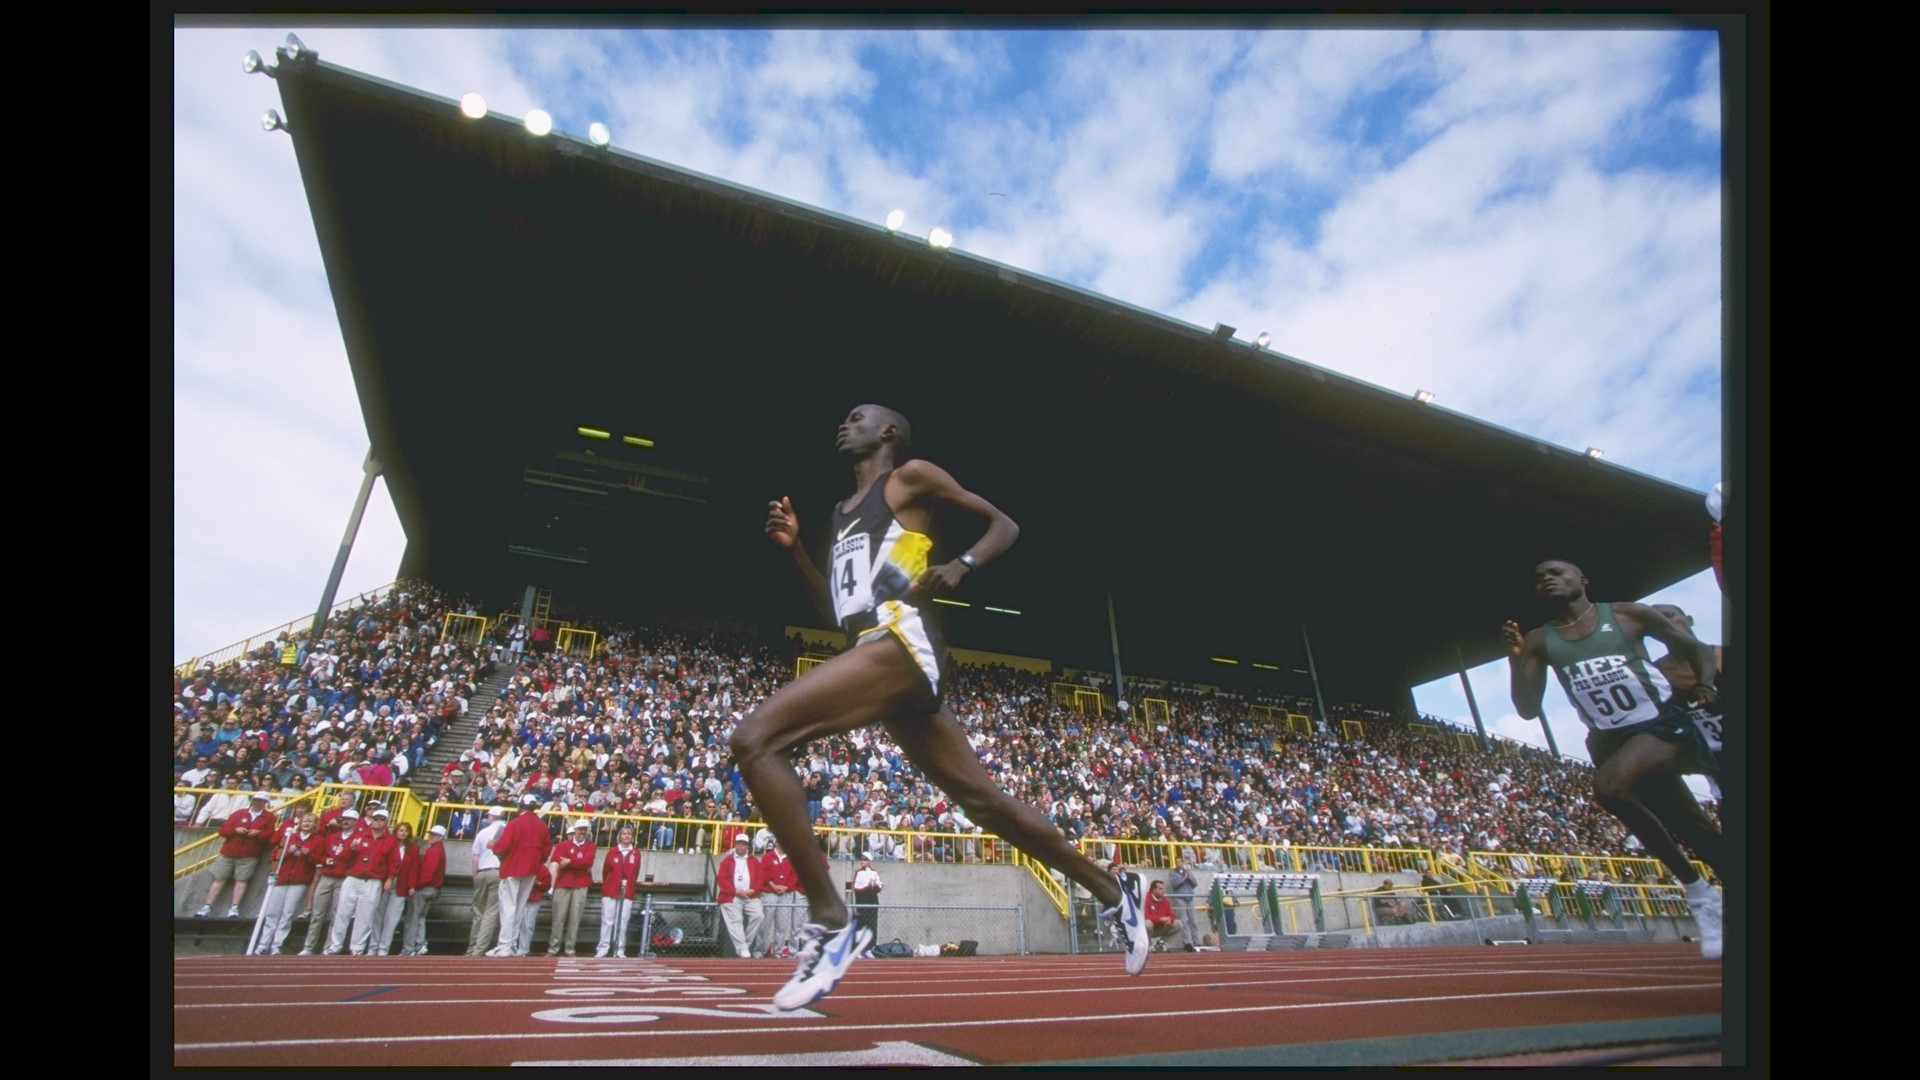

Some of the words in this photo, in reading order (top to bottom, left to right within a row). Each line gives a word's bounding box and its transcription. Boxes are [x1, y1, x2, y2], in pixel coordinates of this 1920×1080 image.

[1590, 669, 1629, 688] CLASSIC
[1587, 684, 1637, 717] 50
[530, 1004, 827, 1023] 2
